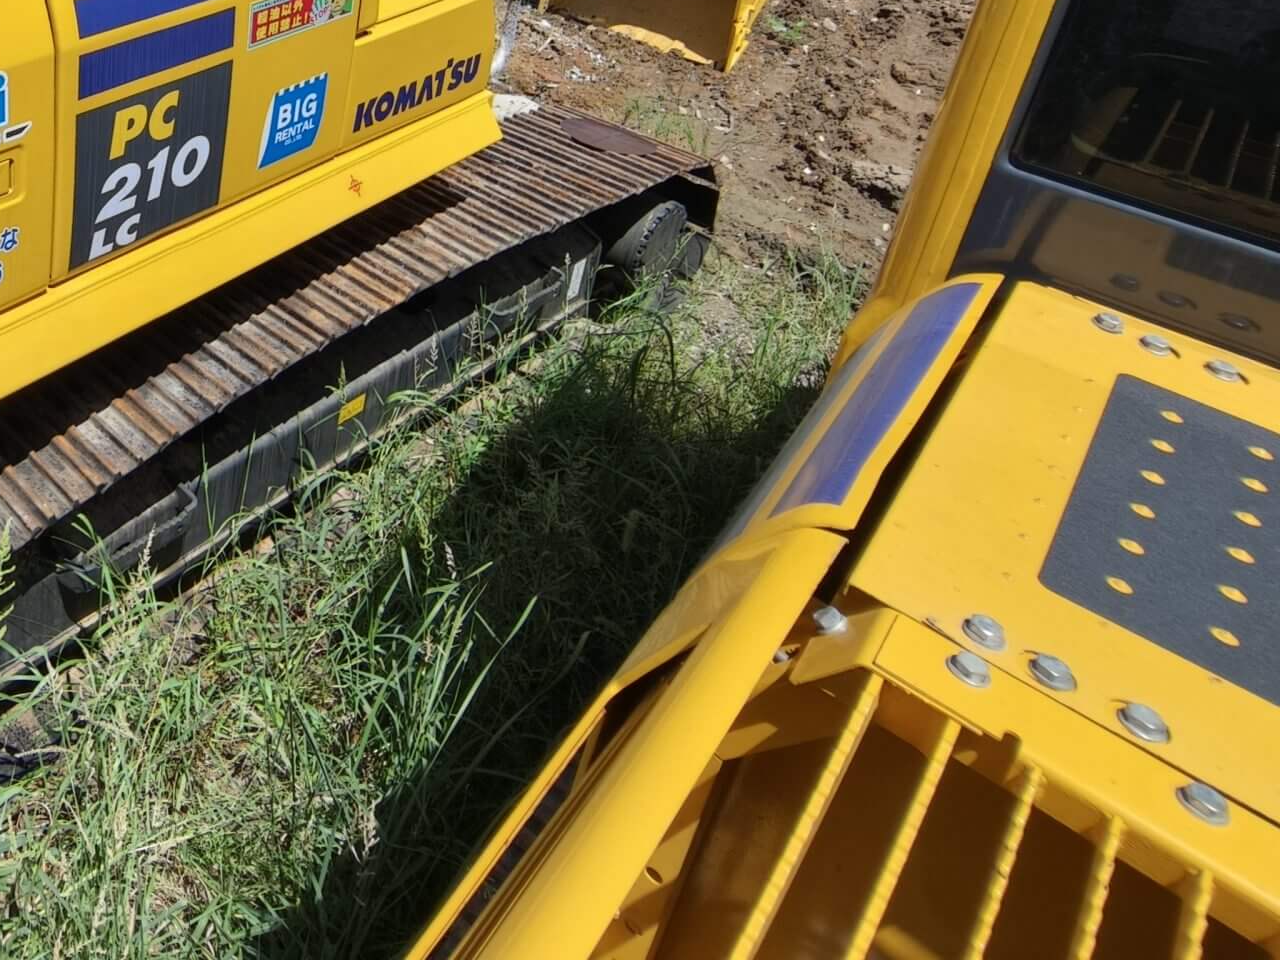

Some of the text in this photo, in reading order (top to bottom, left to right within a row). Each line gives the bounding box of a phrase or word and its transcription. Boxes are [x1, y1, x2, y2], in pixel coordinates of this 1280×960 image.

[277, 92, 318, 130] BIG
[353, 52, 482, 133] KOMATSU
[109, 90, 180, 161] PC
[274, 118, 316, 144] RENTAL
[94, 135, 210, 225] 210
[88, 212, 142, 262] LC
